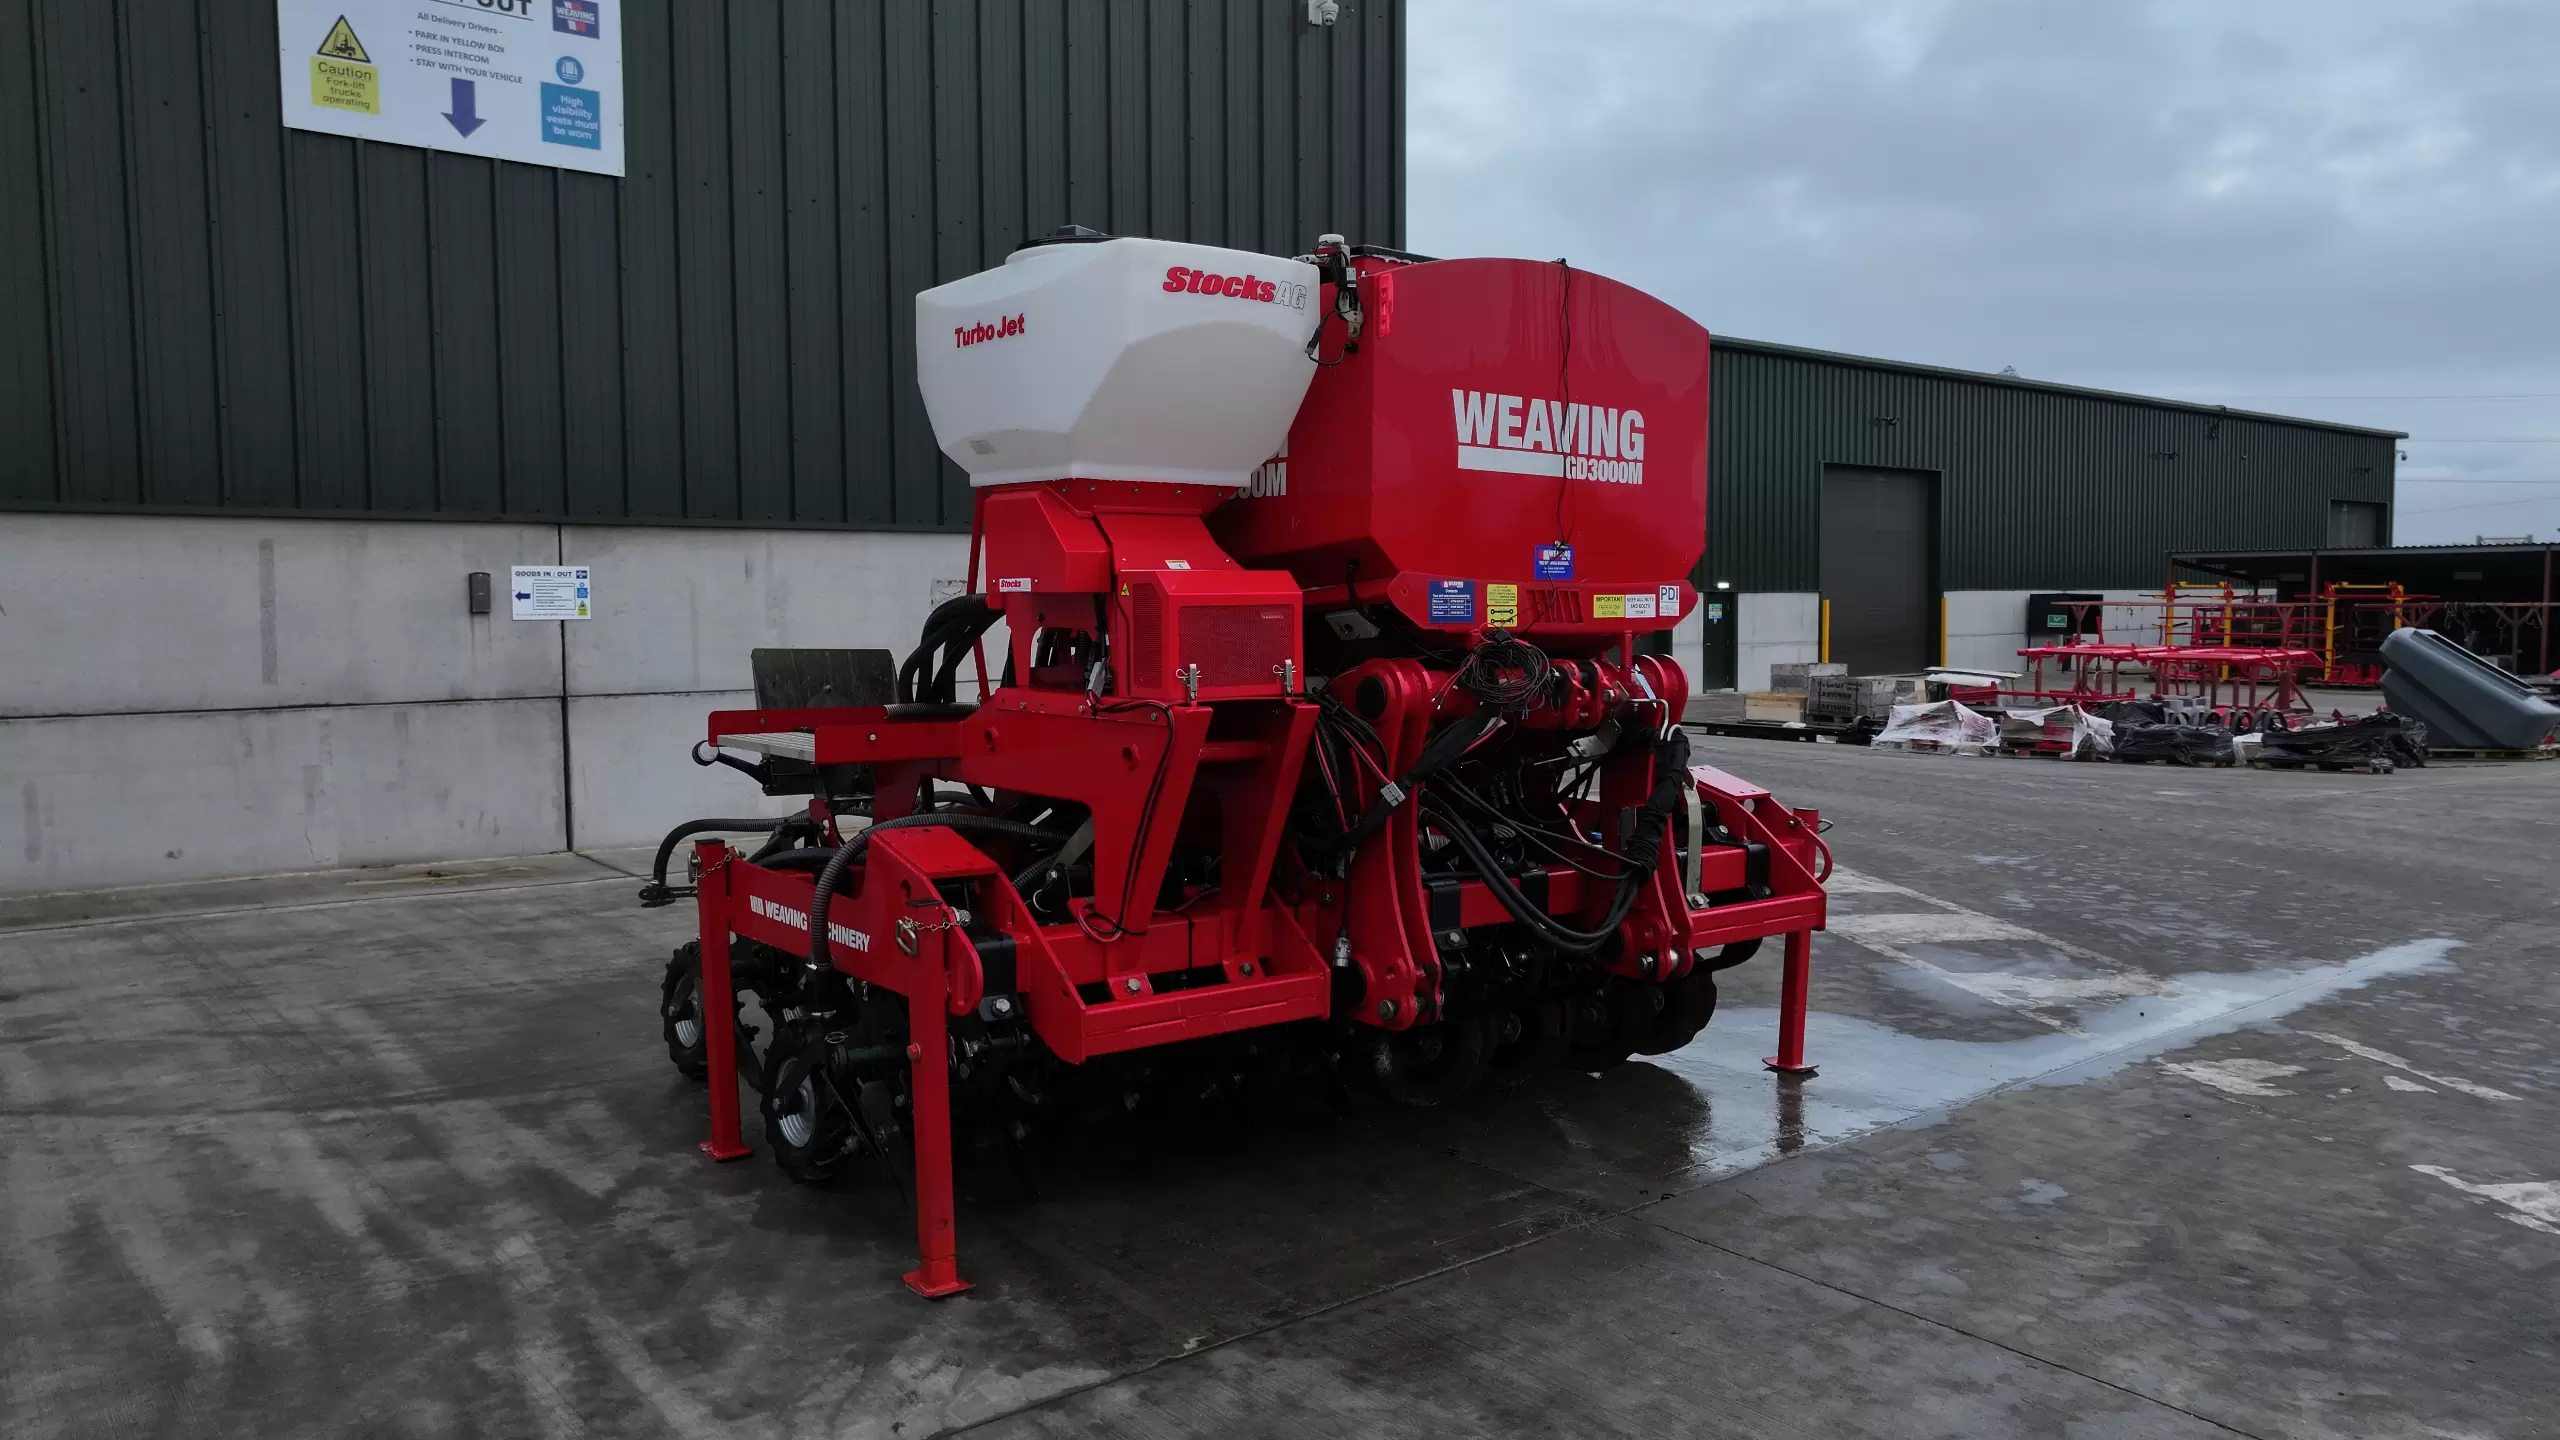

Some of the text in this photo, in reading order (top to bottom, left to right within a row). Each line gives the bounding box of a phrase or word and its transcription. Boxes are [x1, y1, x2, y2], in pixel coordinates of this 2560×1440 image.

[556, 6, 596, 21] WEAVING
[417, 12, 429, 21] All
[431, 15, 466, 29] Delivery
[468, 22, 497, 35] Drivers
[415, 30, 505, 54] PARK IN YELLOW BOX
[416, 44, 490, 65] PRESS INTERCOM
[318, 61, 372, 80] Caution
[416, 58, 523, 84] STAY WITH YOUR VEHICLE
[326, 76, 365, 90] Fork-lift
[330, 87, 362, 98] trucks
[323, 95, 370, 111] operating
[560, 95, 584, 108] High
[552, 105, 593, 120] visibility
[546, 115, 598, 131] vests must
[552, 126, 592, 140] be worn
[954, 312, 1025, 349] Turbo Jet
[1452, 388, 1645, 461] WEAVING
[1565, 456, 1643, 485] GD3000M
[1000, 579, 1022, 588] Stocks
[1661, 586, 1679, 600] PDI
[765, 900, 808, 931] WEAVING
[810, 915, 870, 953] HINERY
